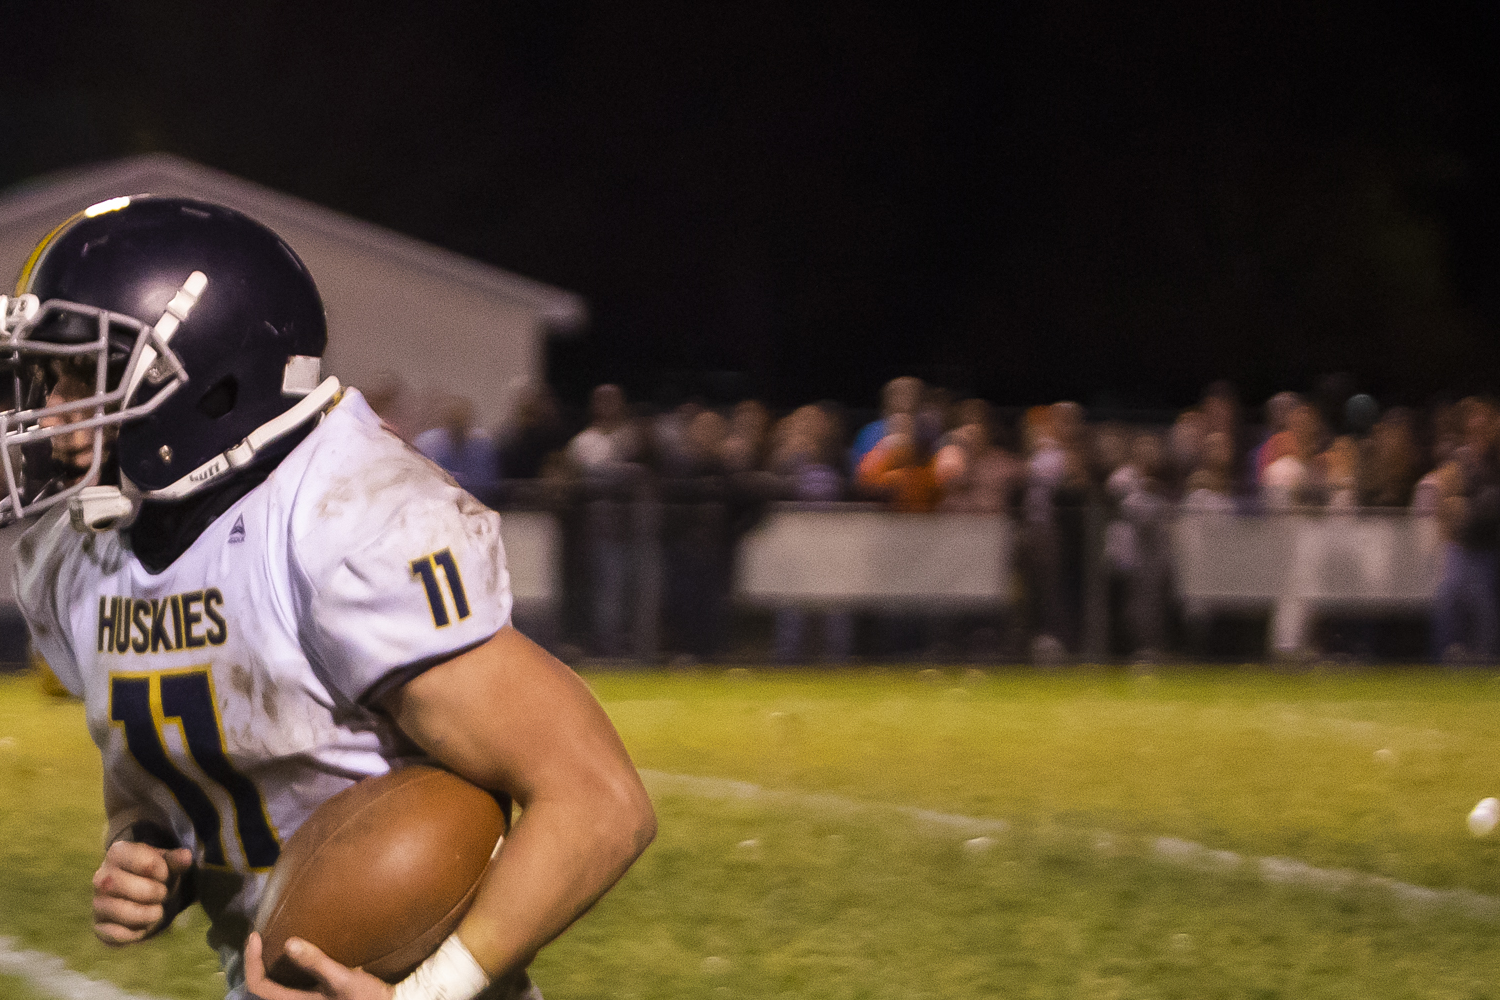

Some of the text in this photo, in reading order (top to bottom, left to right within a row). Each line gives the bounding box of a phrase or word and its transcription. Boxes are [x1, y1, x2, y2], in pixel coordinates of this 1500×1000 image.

[98, 587, 227, 654] HUSKIES
[411, 548, 471, 628] 11
[108, 665, 281, 873] 11
